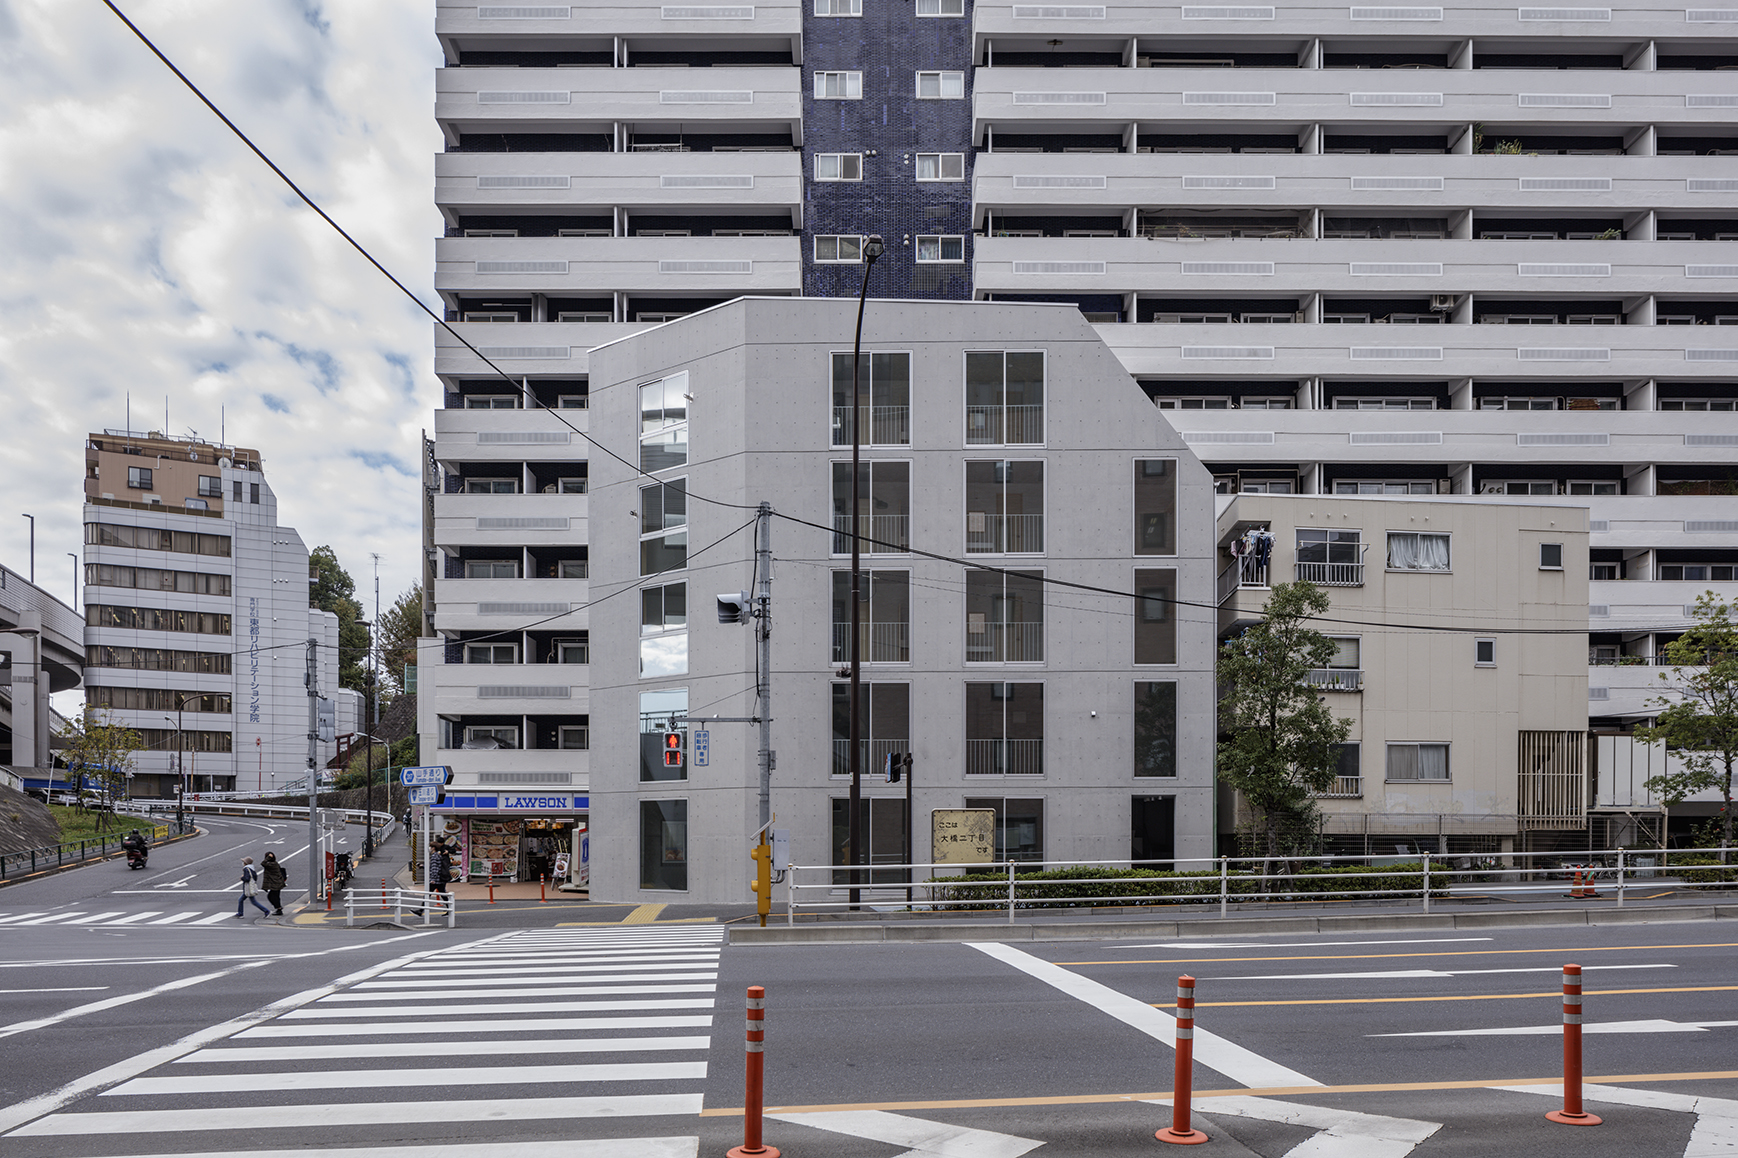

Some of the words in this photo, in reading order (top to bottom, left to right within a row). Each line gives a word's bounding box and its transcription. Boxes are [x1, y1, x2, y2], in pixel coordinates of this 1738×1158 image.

[249, 618, 260, 723] 東都リハビリテーション学院
[416, 768, 441, 778] 山手通り
[504, 797, 567, 808] LAWSON
[940, 834, 985, 843] 大橋二丁目
